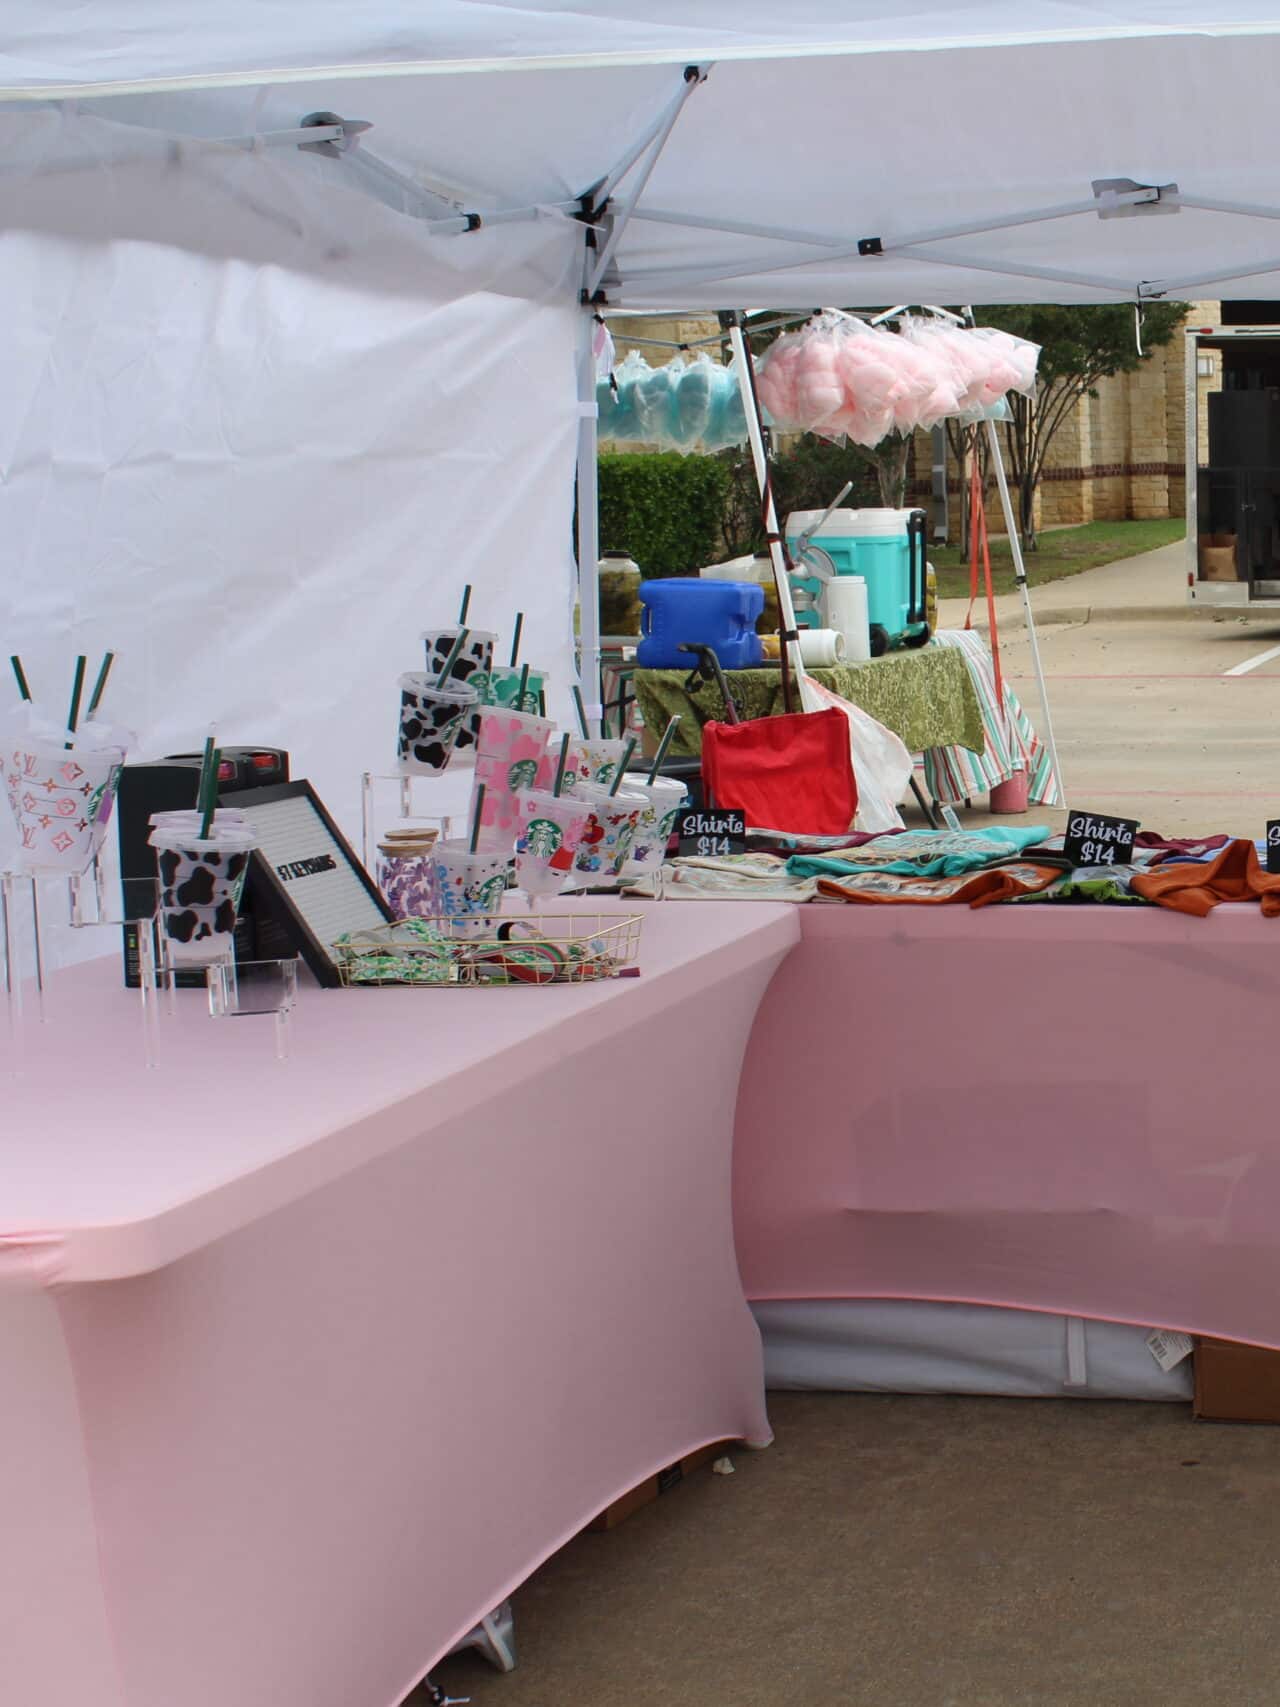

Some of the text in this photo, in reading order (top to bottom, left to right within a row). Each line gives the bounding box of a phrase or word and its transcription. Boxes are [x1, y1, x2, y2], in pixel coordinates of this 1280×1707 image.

[682, 814, 743, 835] Shirts
[1070, 817, 1132, 844] Shirts
[697, 835, 730, 856] $14
[1080, 841, 1115, 866] $14
